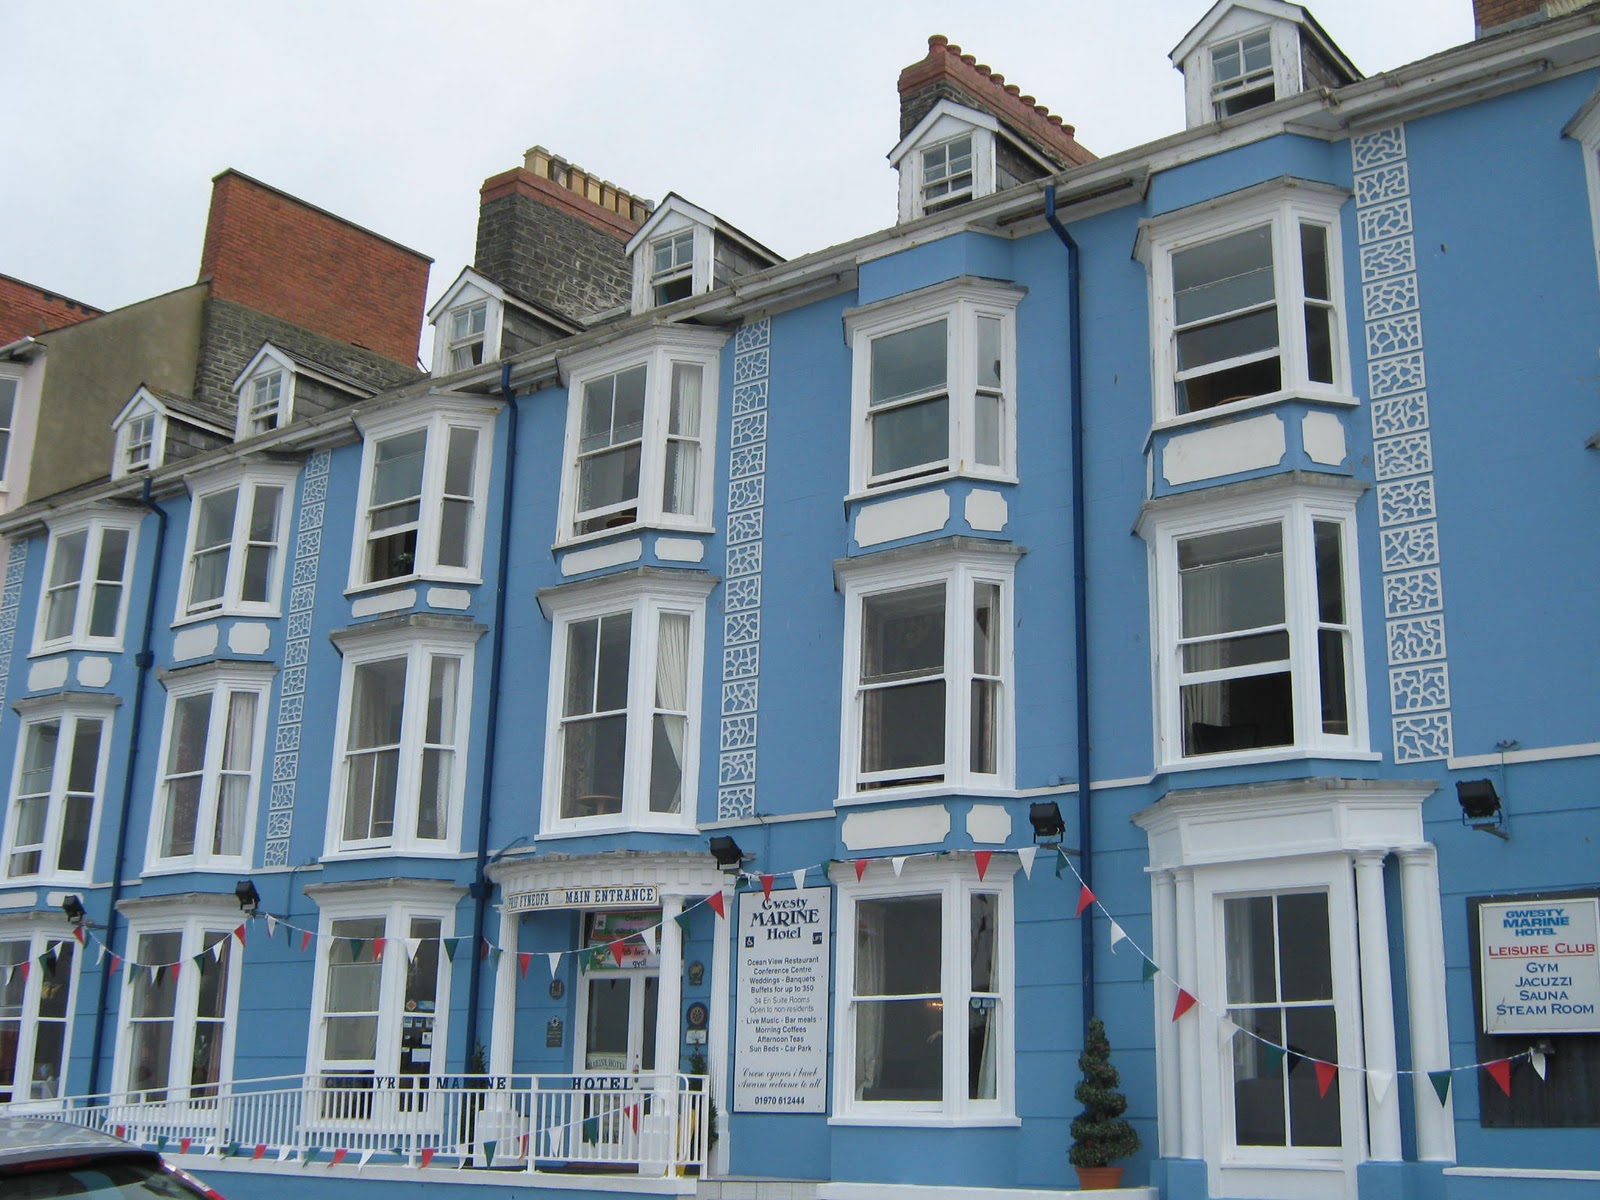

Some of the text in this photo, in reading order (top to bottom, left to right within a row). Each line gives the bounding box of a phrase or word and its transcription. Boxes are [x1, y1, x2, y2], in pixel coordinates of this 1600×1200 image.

[565, 890, 591, 904] MAIN
[594, 888, 654, 903] ENTRANCE
[762, 897, 808, 910] Gwesty
[750, 908, 820, 927] MARINE
[1505, 908, 1565, 918] GWESTY
[1503, 916, 1569, 928] MARINE
[767, 926, 801, 940] Hotel
[1515, 927, 1557, 937] HOTEL
[1488, 942, 1596, 957] LEISURE CLUB
[747, 956, 819, 966] Ocean View Restaurant
[753, 966, 812, 975] Conference Centre
[1526, 962, 1559, 974] GYM
[749, 977, 780, 985] Weddings
[785, 975, 816, 984] Banquets
[1515, 976, 1572, 988] JACUZZI
[750, 986, 773, 994] Buffets
[774, 985, 783, 993] for
[802, 984, 814, 992] 350
[763, 996, 772, 1004] En
[772, 996, 788, 1004] Suite
[789, 996, 811, 1004] Rooms
[1519, 990, 1569, 1001] SAUNA
[749, 1006, 766, 1014] Open
[1496, 1003, 1594, 1016] STEAM ROOM
[746, 1017, 760, 1025] Live
[760, 1016, 780, 1024] Music
[785, 1016, 797, 1024] Bar
[755, 1026, 781, 1034] Morning
[749, 1045, 762, 1053] Sun
[763, 1045, 779, 1053] Beds
[572, 1077, 634, 1090] HOTEL
[809, 1078, 822, 1088] all
[754, 1096, 777, 1105] 01970
